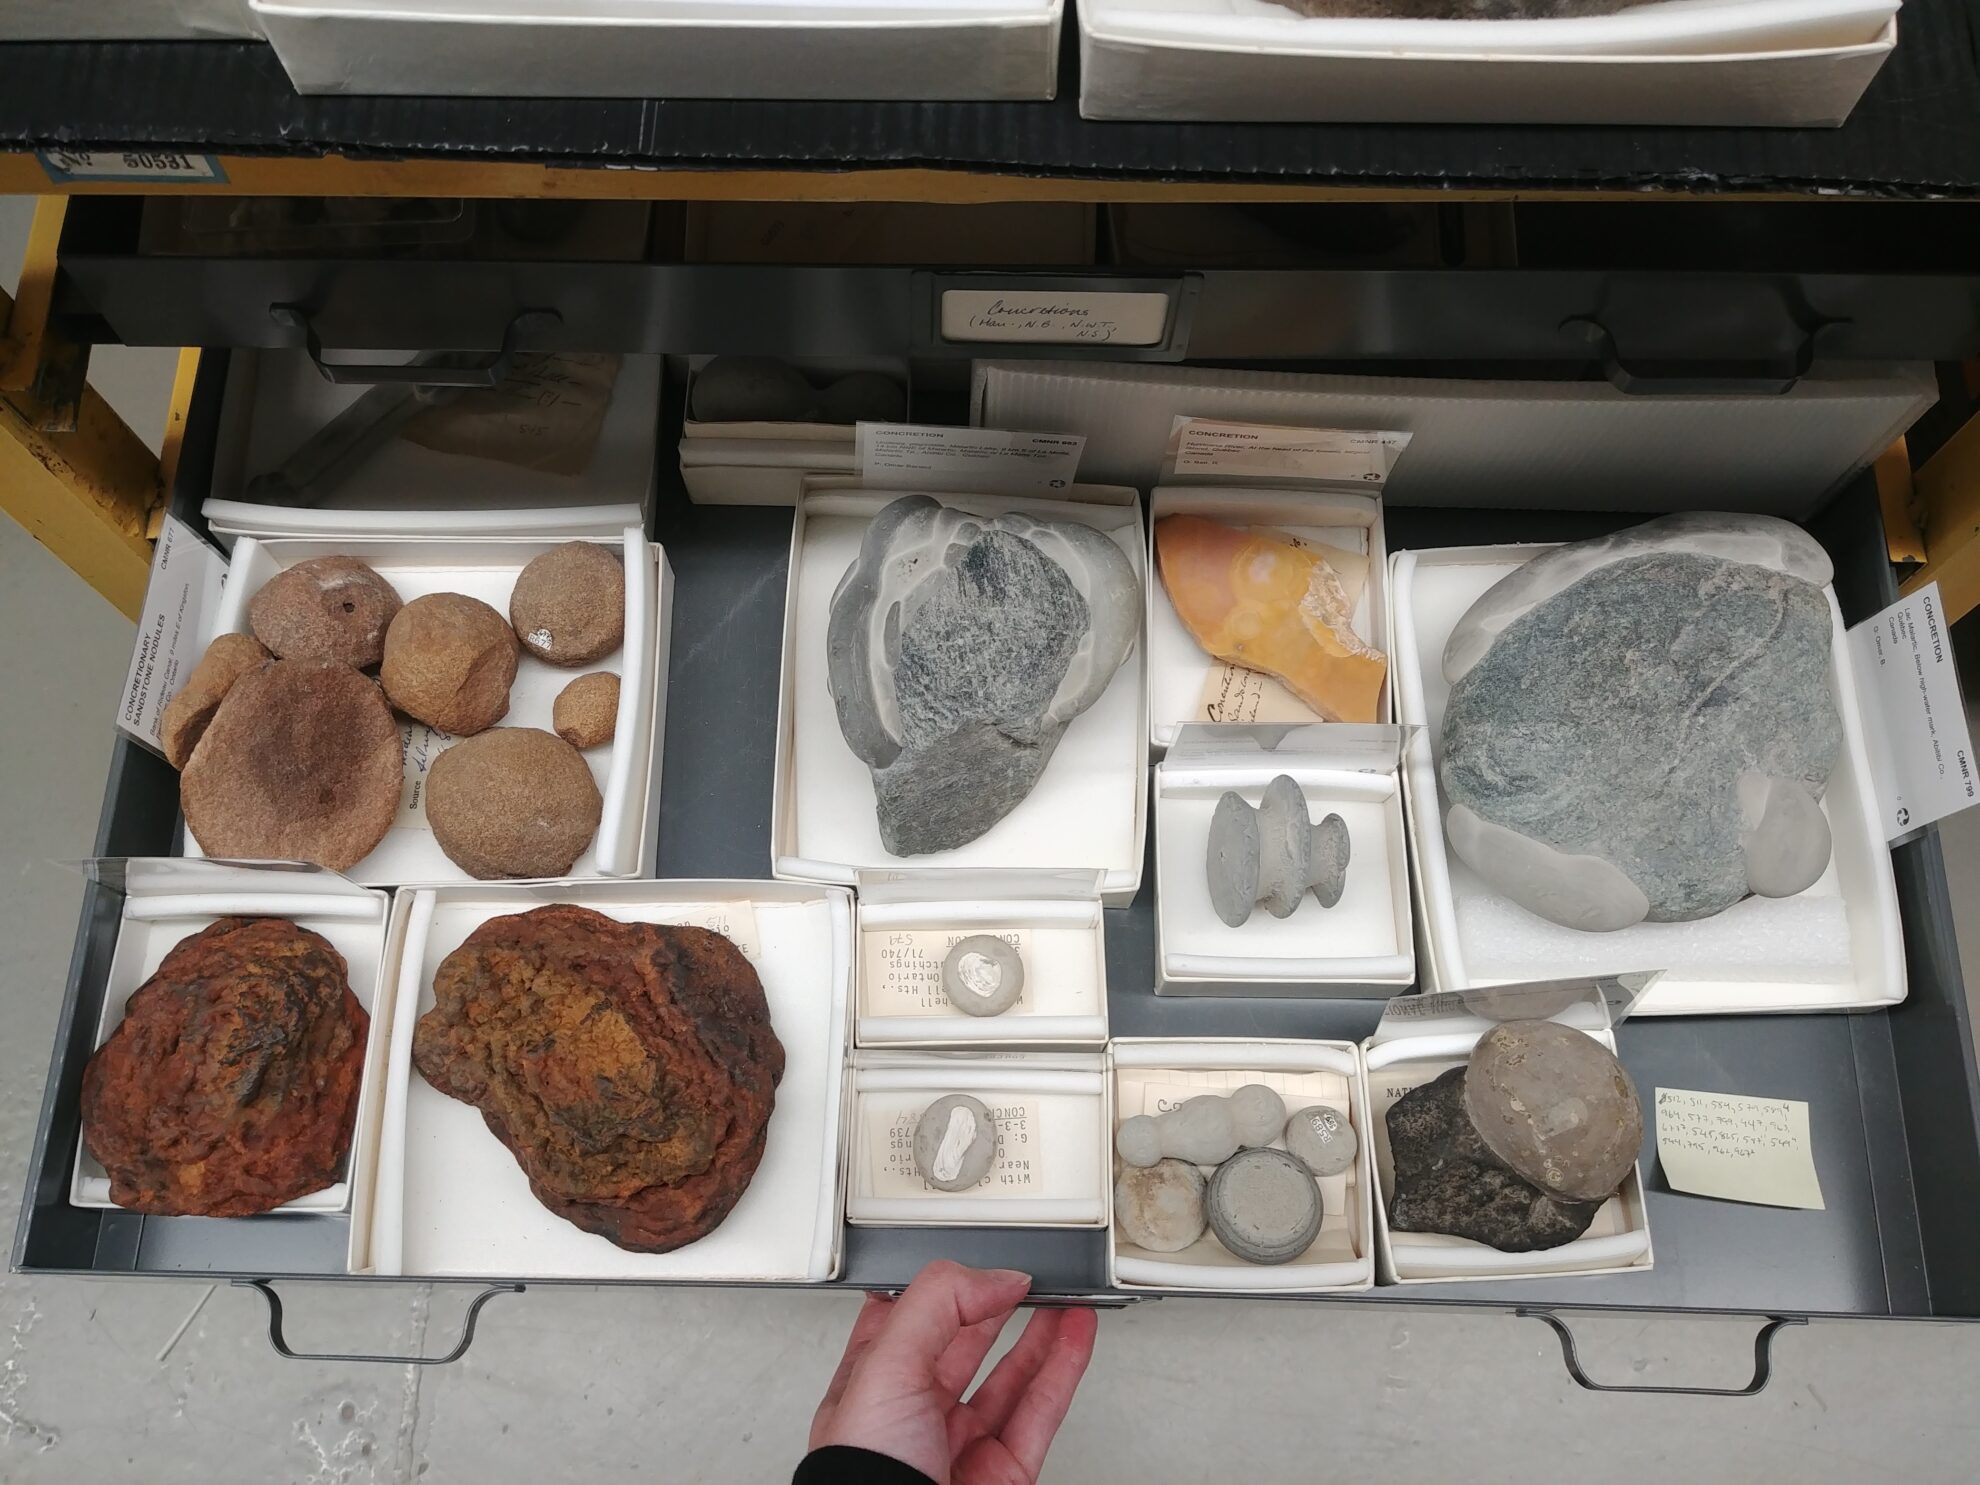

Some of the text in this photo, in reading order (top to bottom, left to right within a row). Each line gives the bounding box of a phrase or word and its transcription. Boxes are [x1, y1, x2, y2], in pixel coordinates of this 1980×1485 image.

[1188, 430, 1258, 440] CONCRETION
[161, 527, 175, 570] CMNR 677
[529, 634, 552, 649] R677
[1889, 616, 1898, 644] Canada
[1923, 596, 1944, 663] CONCRETION
[125, 633, 151, 721] CONCRETIONARY
[133, 613, 165, 726] SANDSTONE NODULES
[1957, 750, 1975, 797] CMNR 799
[410, 780, 421, 810] Source
[881, 949, 924, 959] 71/740
[882, 985, 918, 995] Hts.,
[888, 973, 940, 983] Ontario
[1311, 1118, 1332, 1143] R589
[999, 1160, 1030, 1170] Near
[1000, 1174, 1031, 1185] With
